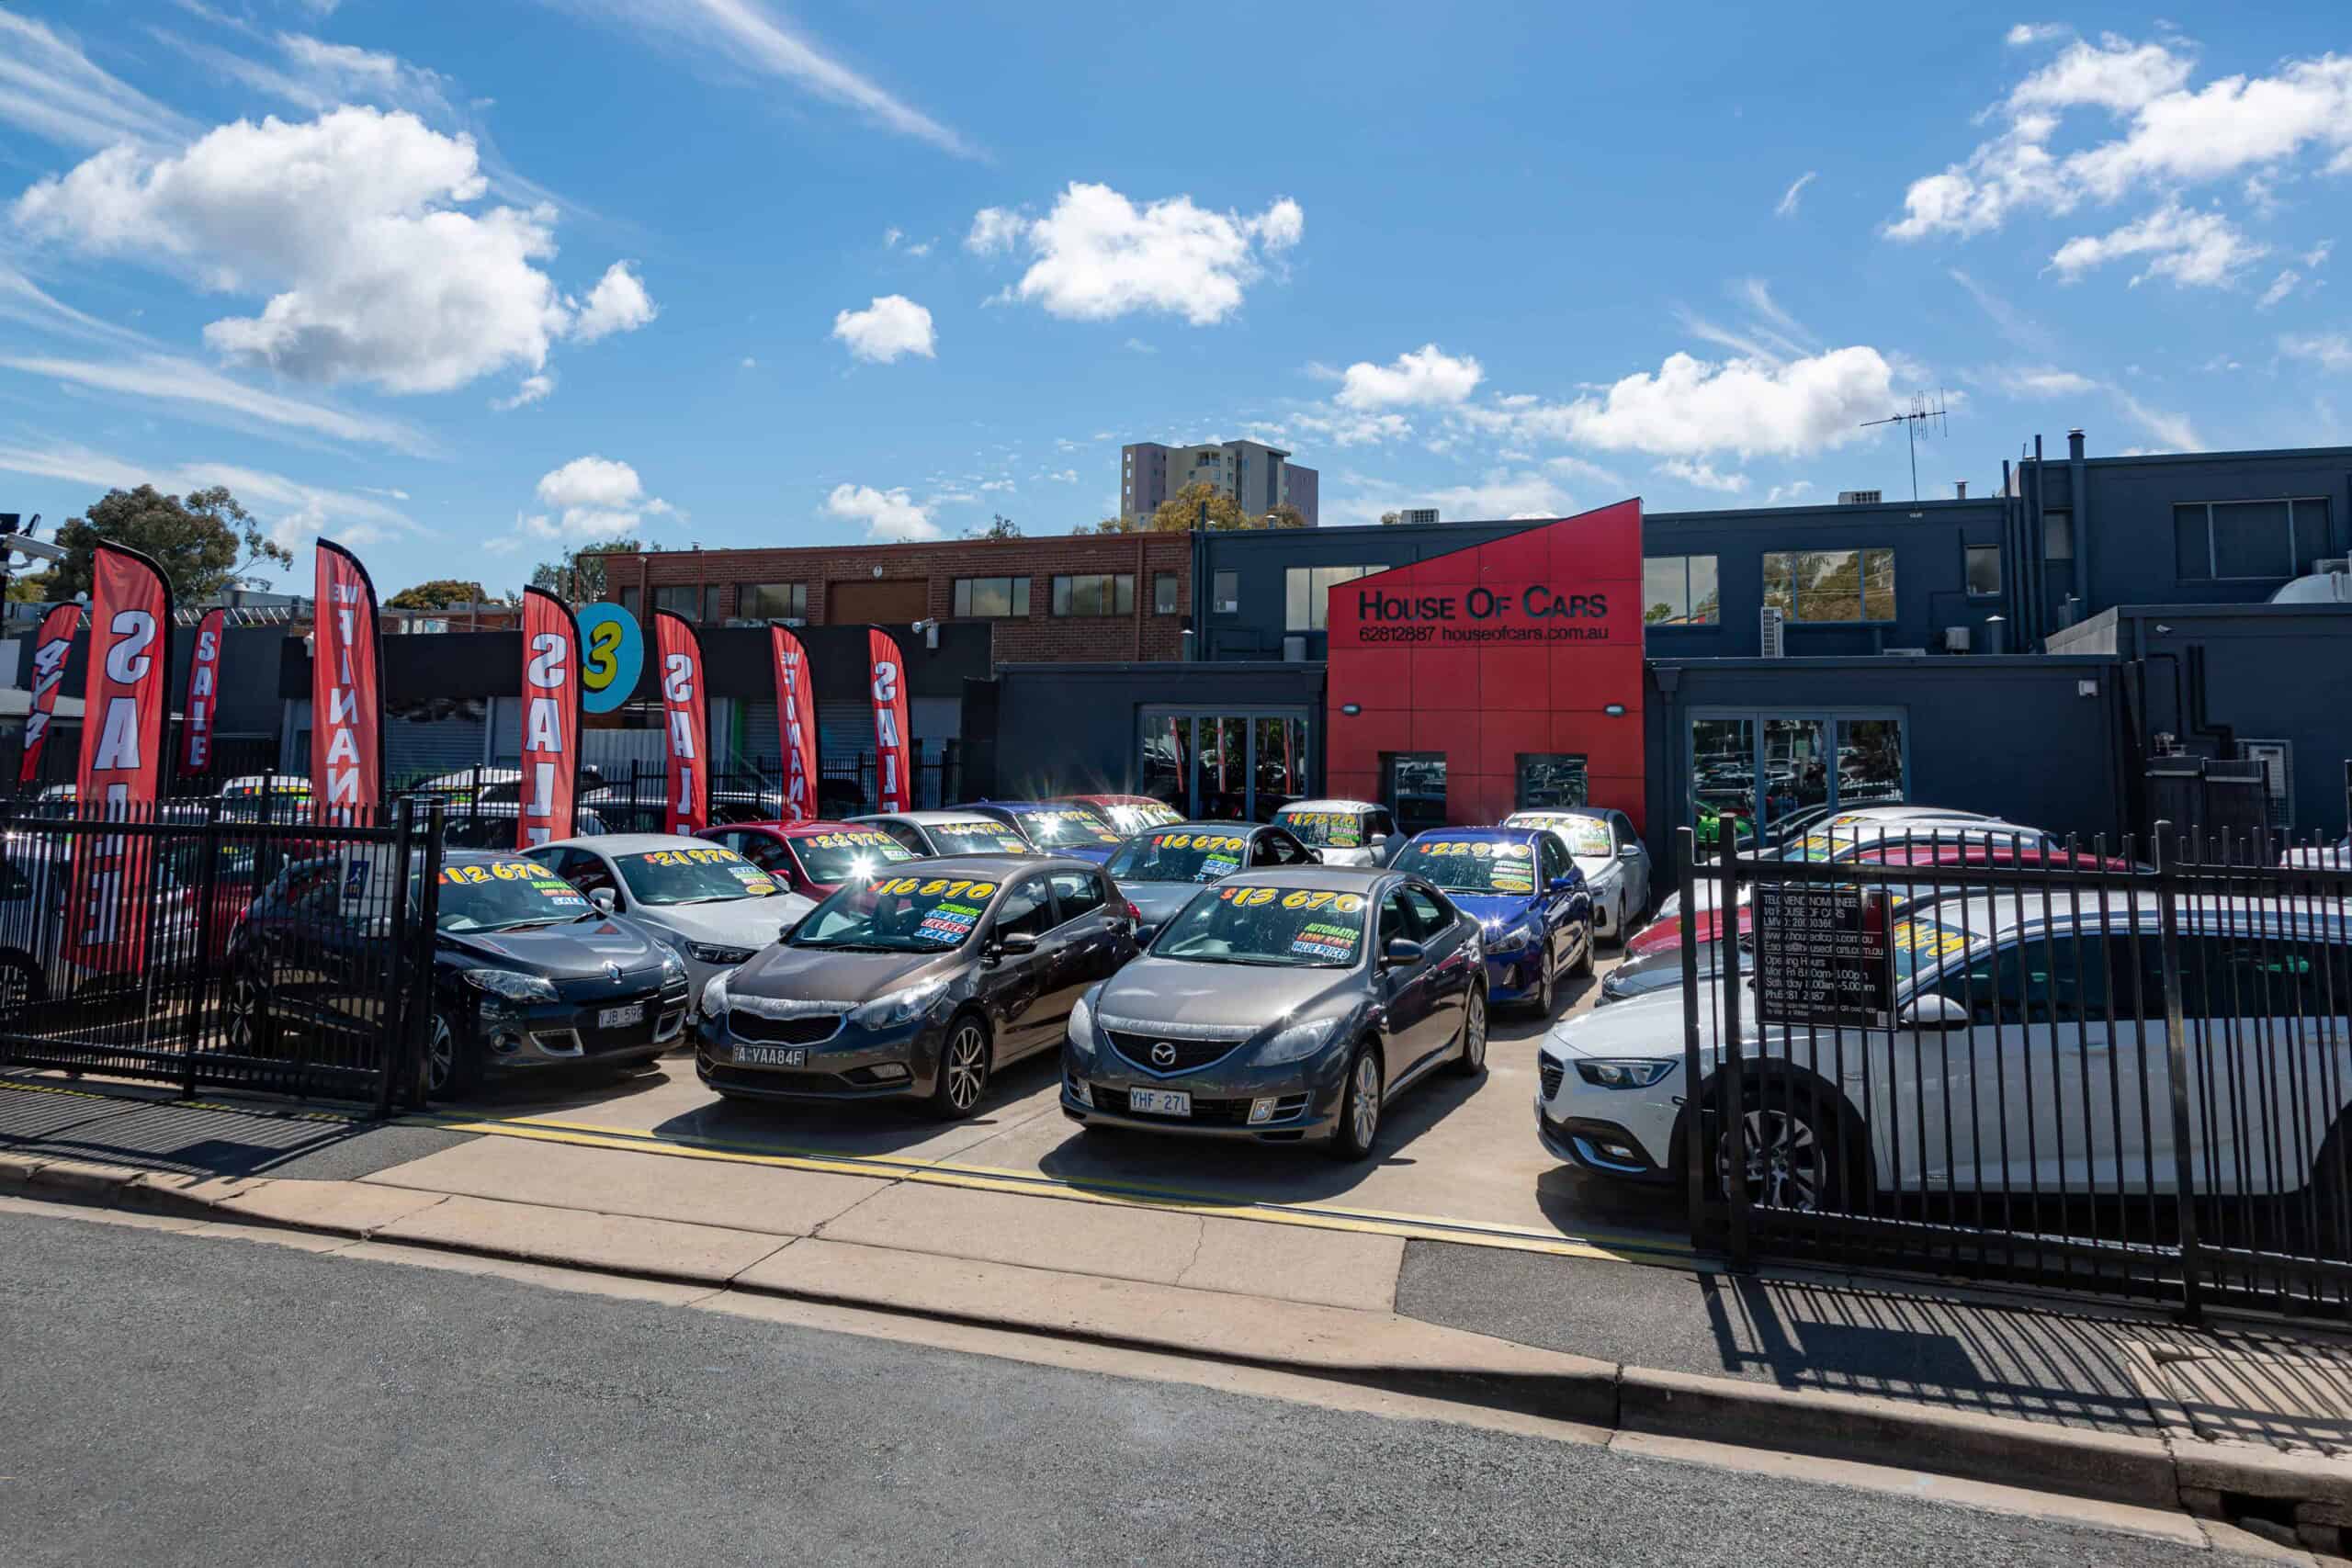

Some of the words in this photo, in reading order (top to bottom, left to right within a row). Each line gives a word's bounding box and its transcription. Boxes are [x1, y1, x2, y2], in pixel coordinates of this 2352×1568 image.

[1359, 592, 1455, 621] HOUSE
[1466, 588, 1512, 619] OF
[1523, 585, 1608, 618] CARS
[1359, 626, 1436, 642] 62812887
[1442, 625, 1610, 642] houseofcars.com.au
[582, 621, 623, 692] 3
[189, 631, 216, 766] SALE
[913, 928, 964, 943] SALE
[753, 1048, 802, 1066] YAA84F
